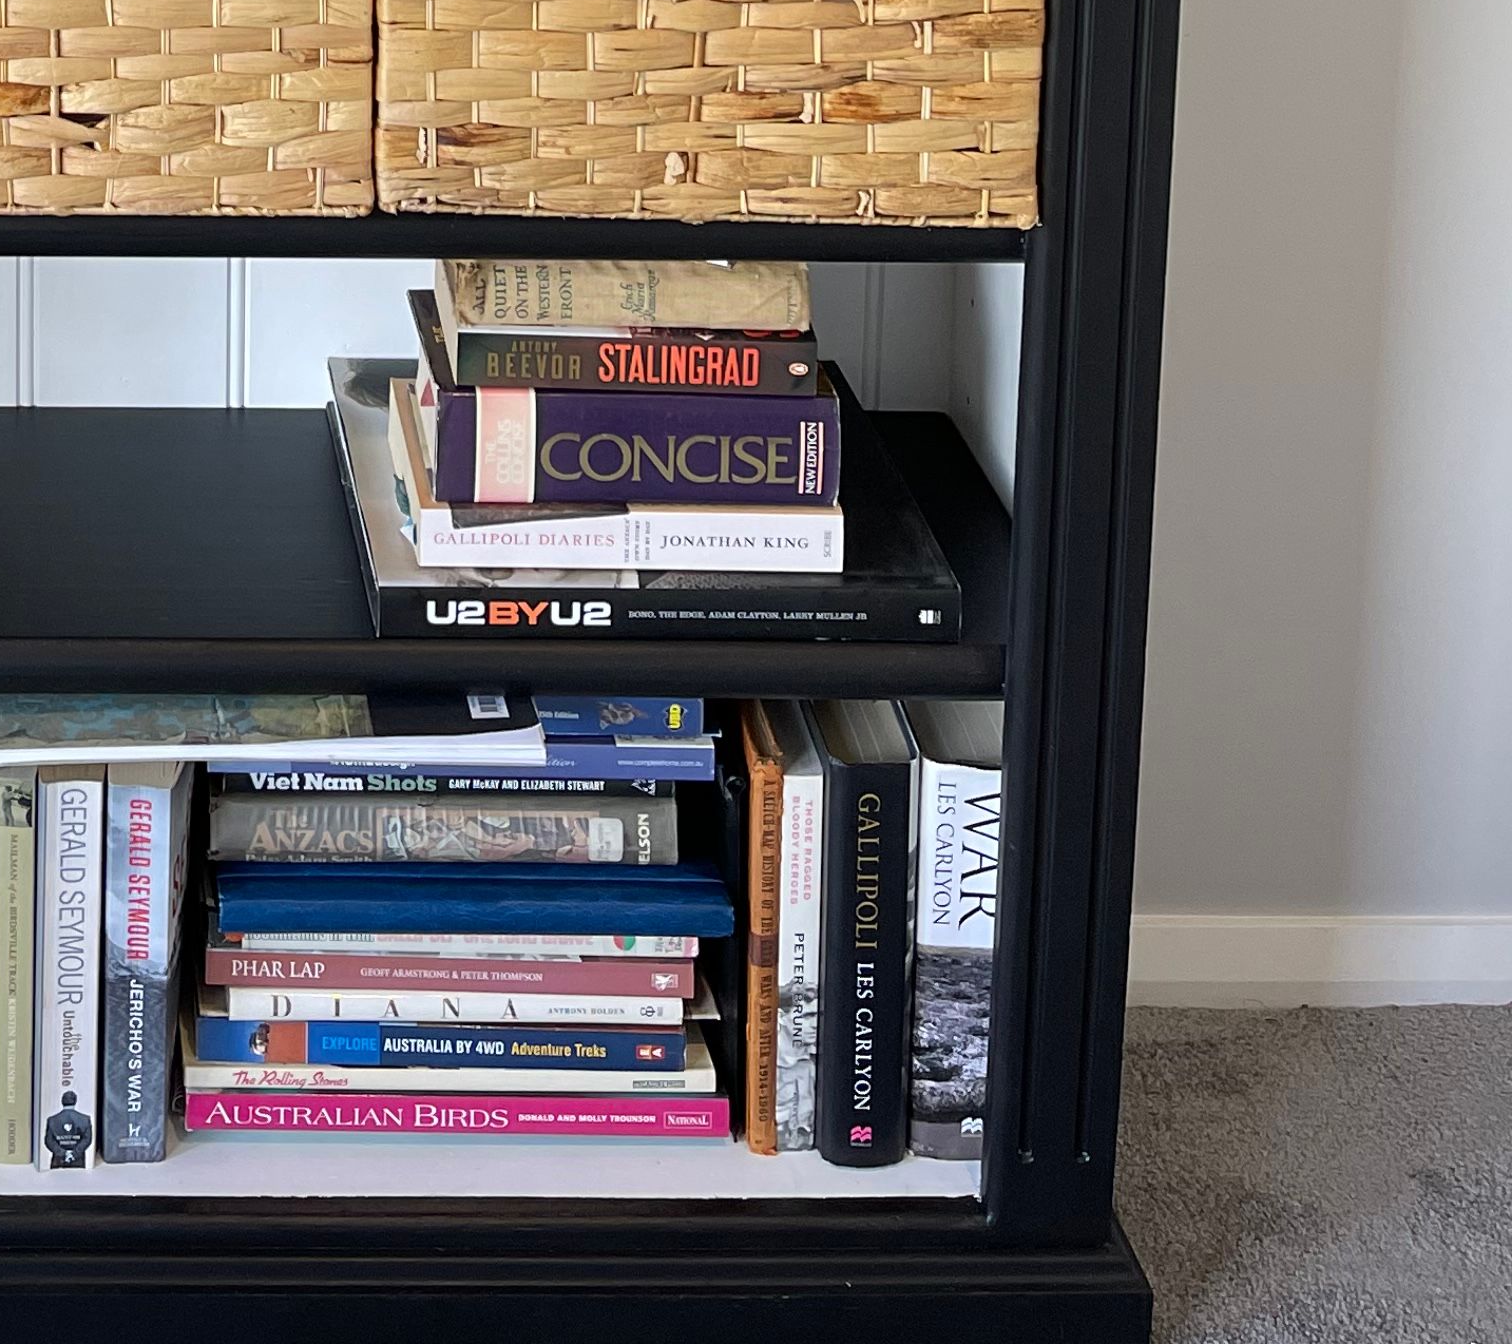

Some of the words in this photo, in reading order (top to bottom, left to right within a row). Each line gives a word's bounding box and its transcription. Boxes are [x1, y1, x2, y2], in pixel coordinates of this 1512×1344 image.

[492, 264, 507, 319] QUIET
[515, 264, 529, 295] THE
[537, 263, 551, 321] WESTERN
[560, 267, 573, 321] FRONT
[515, 296, 529, 319] ON
[487, 352, 581, 381] BEEVOR
[511, 340, 558, 352] ANTONY
[598, 342, 760, 387] STALINGRAD
[540, 431, 797, 485] CONCISE
[806, 422, 817, 468] EDITION
[805, 470, 816, 494] NEW
[433, 532, 531, 546] GALLIPOLI
[539, 533, 616, 547] DIARIES
[659, 535, 756, 549] JONATHAN
[763, 537, 809, 549] KING
[249, 772, 301, 790] Viet
[303, 772, 363, 791] Nam
[366, 773, 437, 792] Shots
[448, 778, 471, 790] GARY
[472, 779, 499, 790] McKAY
[501, 779, 519, 791] AND
[521, 779, 565, 791] ELIZABETH
[567, 780, 605, 792] STEWART
[937, 781, 957, 815] LES
[60, 788, 88, 884] GERALD
[129, 799, 152, 868] GERALD
[248, 821, 375, 854] ANZACS
[791, 795, 802, 849] BLOODY
[804, 800, 814, 847] THOSE
[790, 852, 801, 906] HEROES
[803, 848, 813, 901] RAGGED
[855, 792, 881, 950] GALLIPOLI
[932, 823, 956, 925] CARLYON
[958, 792, 1001, 931] WAR
[127, 874, 151, 961] SEYMOUR
[57, 890, 86, 1006] SEYMOUR
[231, 959, 286, 979] PHAR
[289, 961, 326, 979] LAP
[794, 932, 805, 985] PETER
[360, 968, 390, 978] GEOFF
[392, 969, 450, 979] ARMSTRONG
[451, 971, 459, 980] &
[460, 970, 489, 981] PETER
[490, 971, 544, 982] THOMPSON
[856, 962, 875, 999] LES
[129, 979, 144, 1070] JERICHO'S
[792, 992, 804, 1048] BRUNE
[61, 1010, 76, 1087] Untouchable
[322, 1036, 377, 1051] EXPLORE
[383, 1038, 453, 1054] AUSTRALIA
[456, 1040, 473, 1054] BY
[475, 1040, 505, 1055] 4WD
[511, 1042, 572, 1057] Adventure
[574, 1043, 607, 1058] Treks
[853, 1007, 874, 1111] CARLYON
[128, 1074, 142, 1113] WAR
[232, 1070, 256, 1085] The
[258, 1070, 307, 1089] Rolling
[308, 1071, 349, 1087] Stones
[205, 1101, 404, 1126] AUSTRALIAN
[414, 1103, 509, 1129] BIRDS
[518, 1113, 555, 1123] DONALD
[557, 1114, 576, 1123] AND
[578, 1114, 607, 1123] MOLLY
[609, 1114, 656, 1123] TROUNSON
